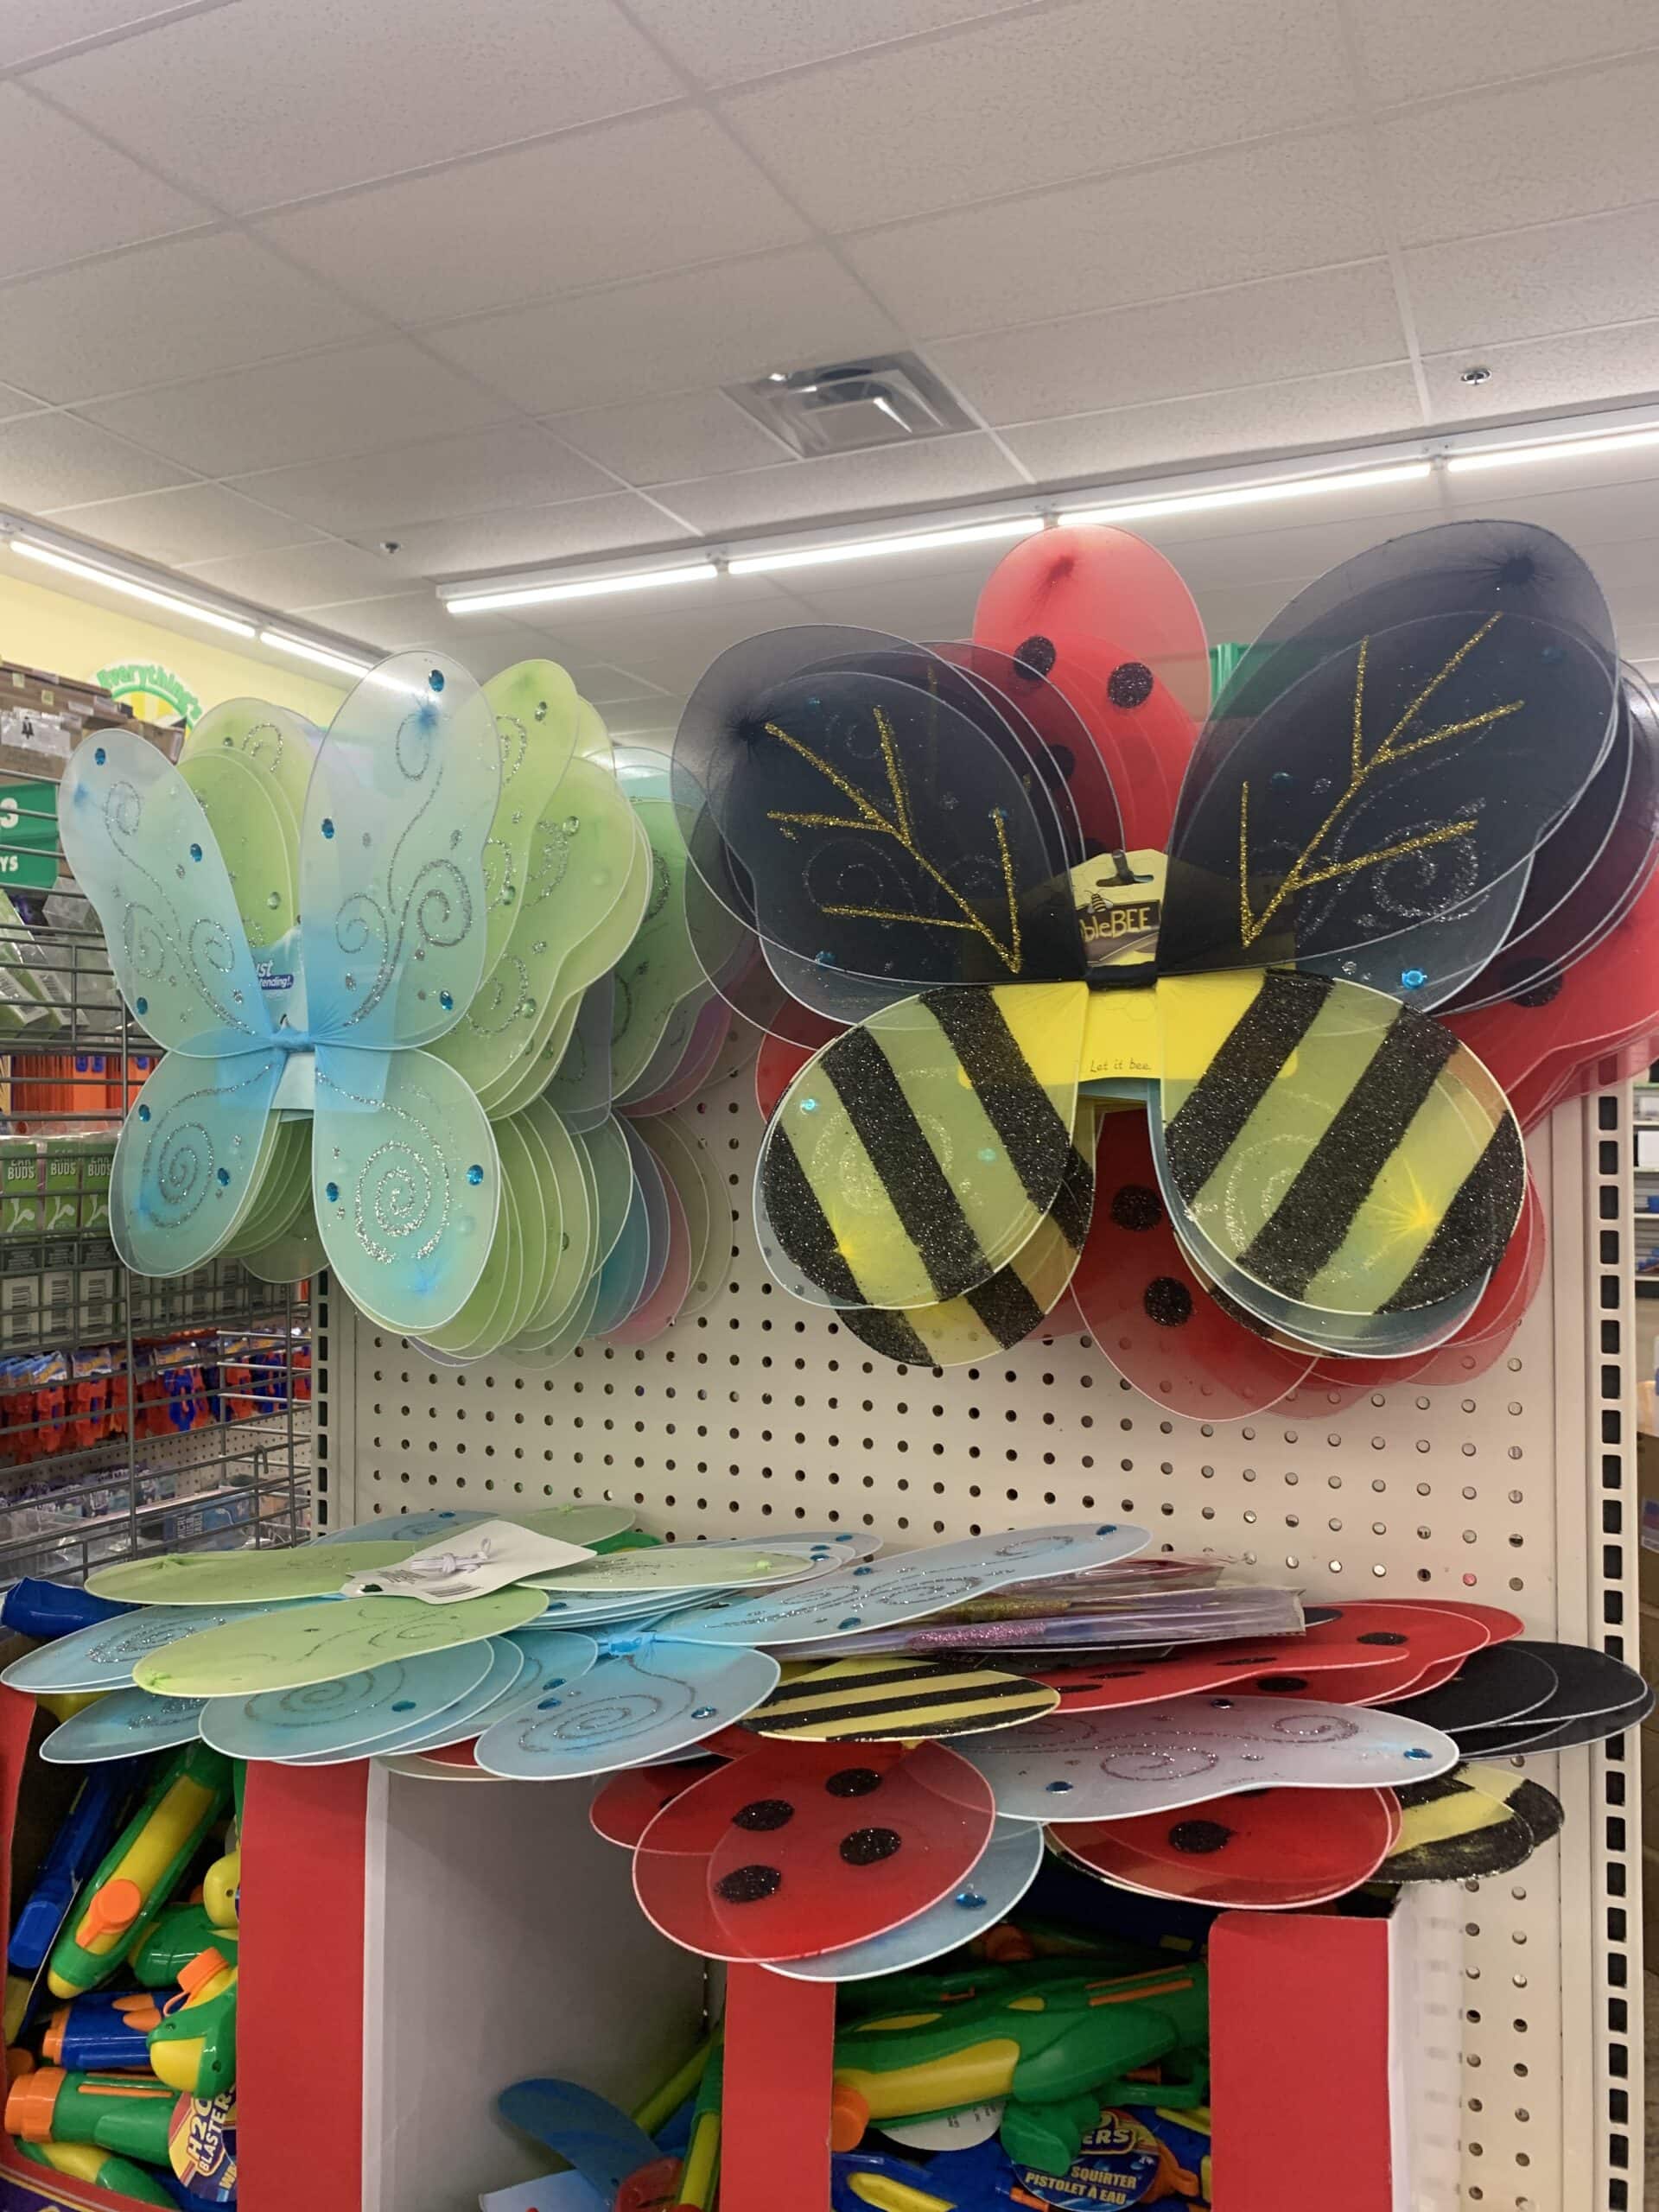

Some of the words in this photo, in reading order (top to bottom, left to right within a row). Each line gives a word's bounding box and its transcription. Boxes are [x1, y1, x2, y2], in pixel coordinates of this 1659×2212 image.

[1128, 1057, 1152, 1071] bee
[7, 1166, 35, 1180] BUDS
[50, 1161, 77, 1176] BUDS
[1071, 2165, 1137, 2190] SQUIRTER
[1024, 2171, 1089, 2196] PISTOLET
[1087, 2185, 1098, 2200] À
[1099, 2189, 1127, 2205] EAU
